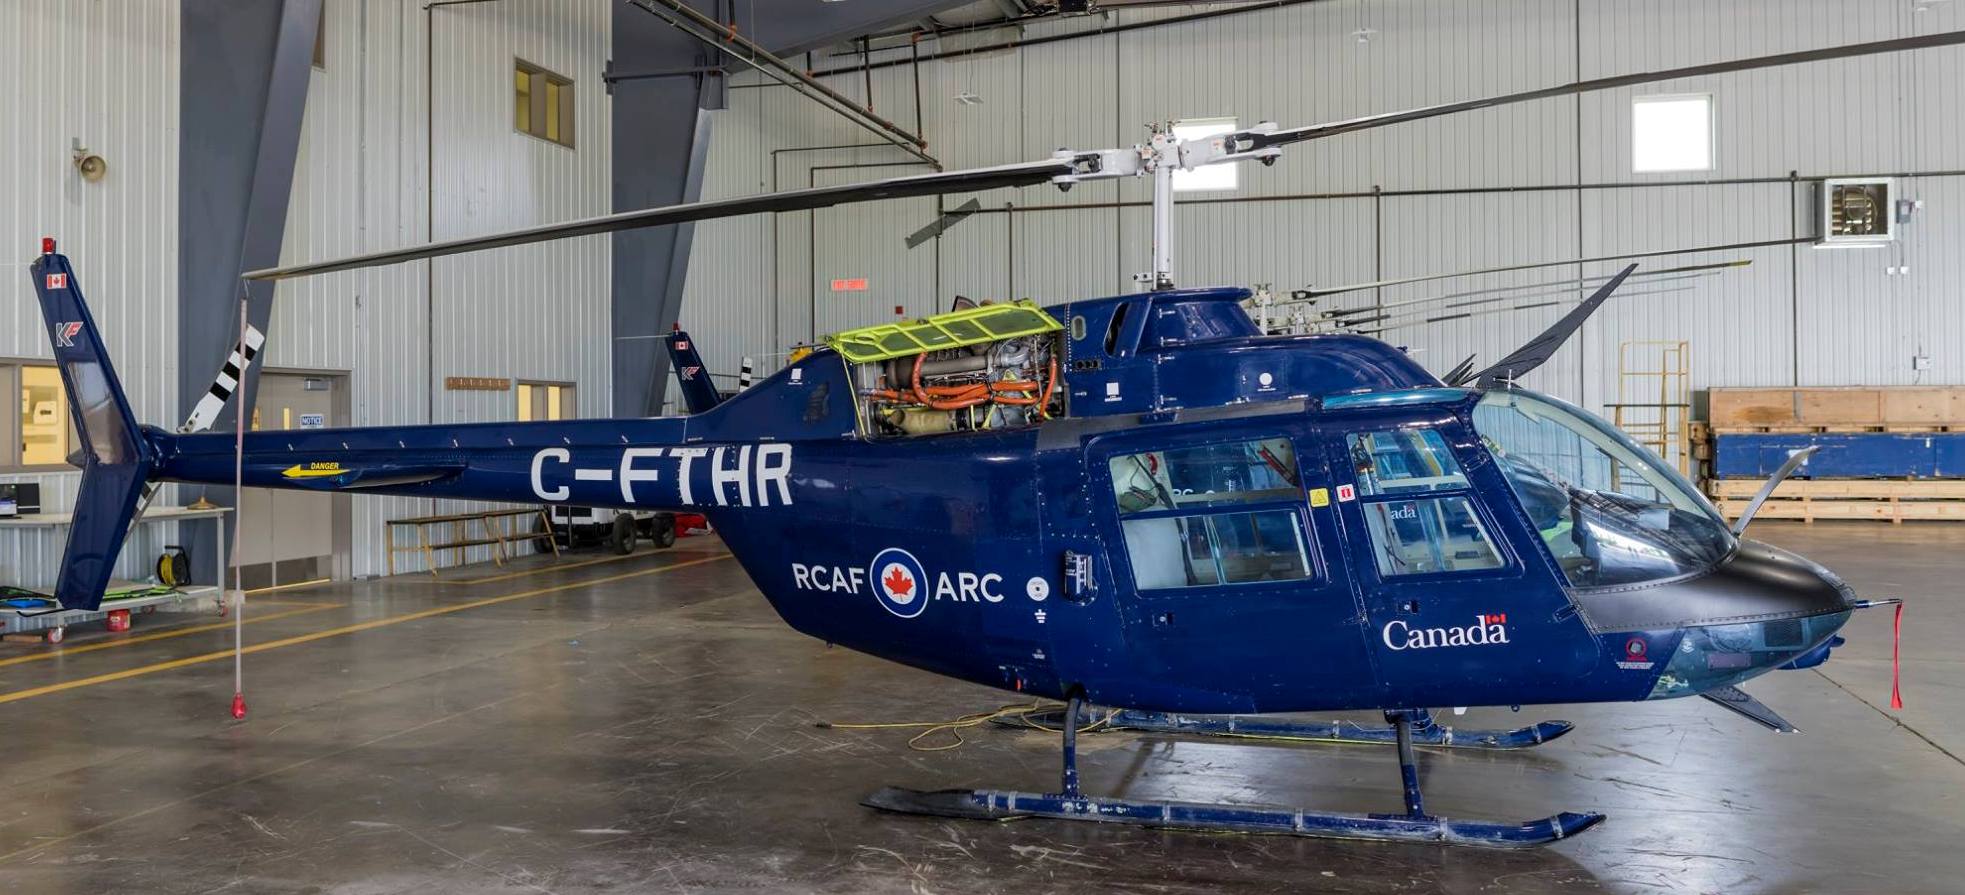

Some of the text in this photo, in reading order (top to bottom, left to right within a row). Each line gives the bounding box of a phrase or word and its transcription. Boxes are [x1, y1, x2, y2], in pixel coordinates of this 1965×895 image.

[302, 417, 321, 425] NOTICE
[310, 461, 339, 470] DANGER
[531, 443, 793, 507] C-FTHR
[1391, 505, 1417, 520] ada
[791, 563, 1005, 603] RCAF ARC
[1382, 614, 1511, 651] Canada
